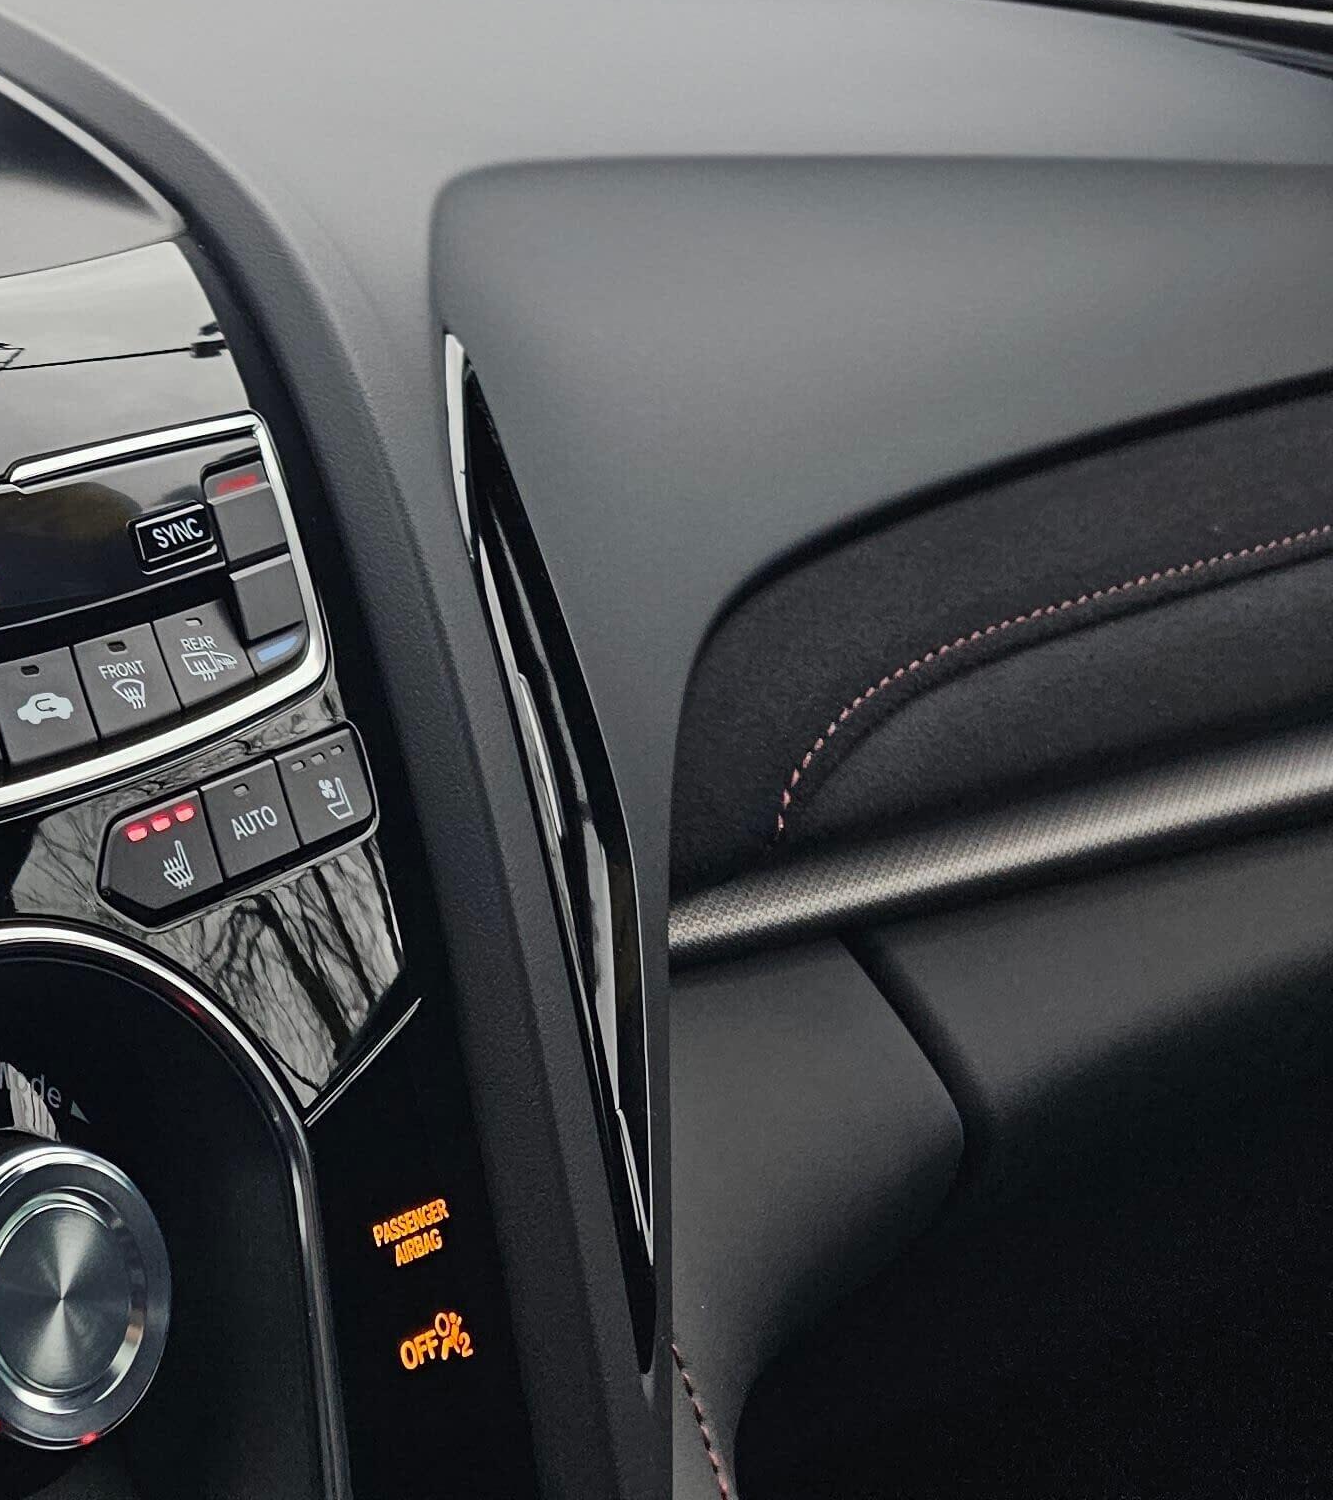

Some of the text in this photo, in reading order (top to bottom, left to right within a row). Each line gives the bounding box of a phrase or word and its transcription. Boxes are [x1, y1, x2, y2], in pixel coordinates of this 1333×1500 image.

[152, 518, 204, 549] SYNC
[180, 635, 218, 652] REAR
[98, 659, 146, 680] FRONT
[231, 805, 278, 841] AUTO
[372, 1198, 450, 1247] PASSENGER
[394, 1228, 443, 1267] AIRBAG
[400, 1329, 439, 1371] OFF
